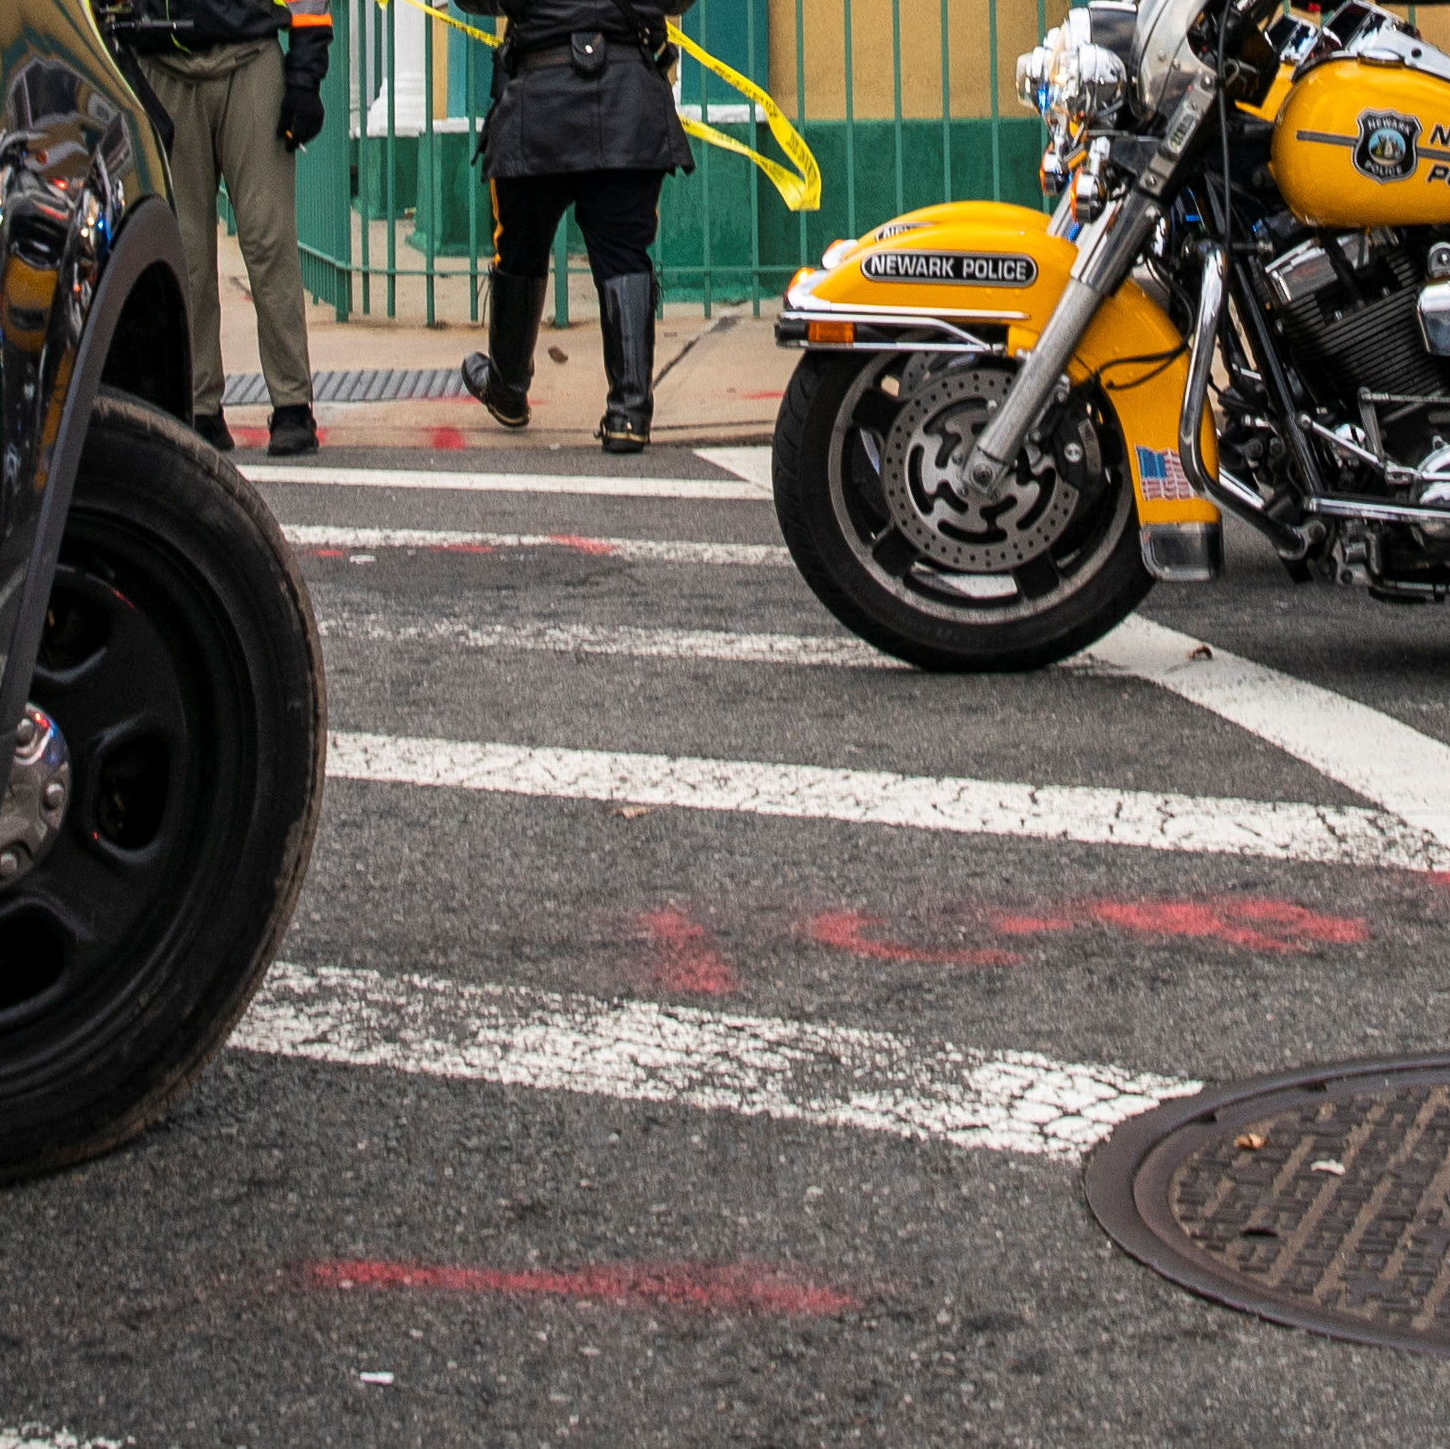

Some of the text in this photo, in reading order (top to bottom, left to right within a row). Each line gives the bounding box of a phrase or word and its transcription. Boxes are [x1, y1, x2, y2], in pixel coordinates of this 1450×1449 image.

[1367, 118, 1413, 136] NEWARK
[1365, 161, 1403, 177] POLICE
[870, 254, 1028, 281] NEWARK POLICE
